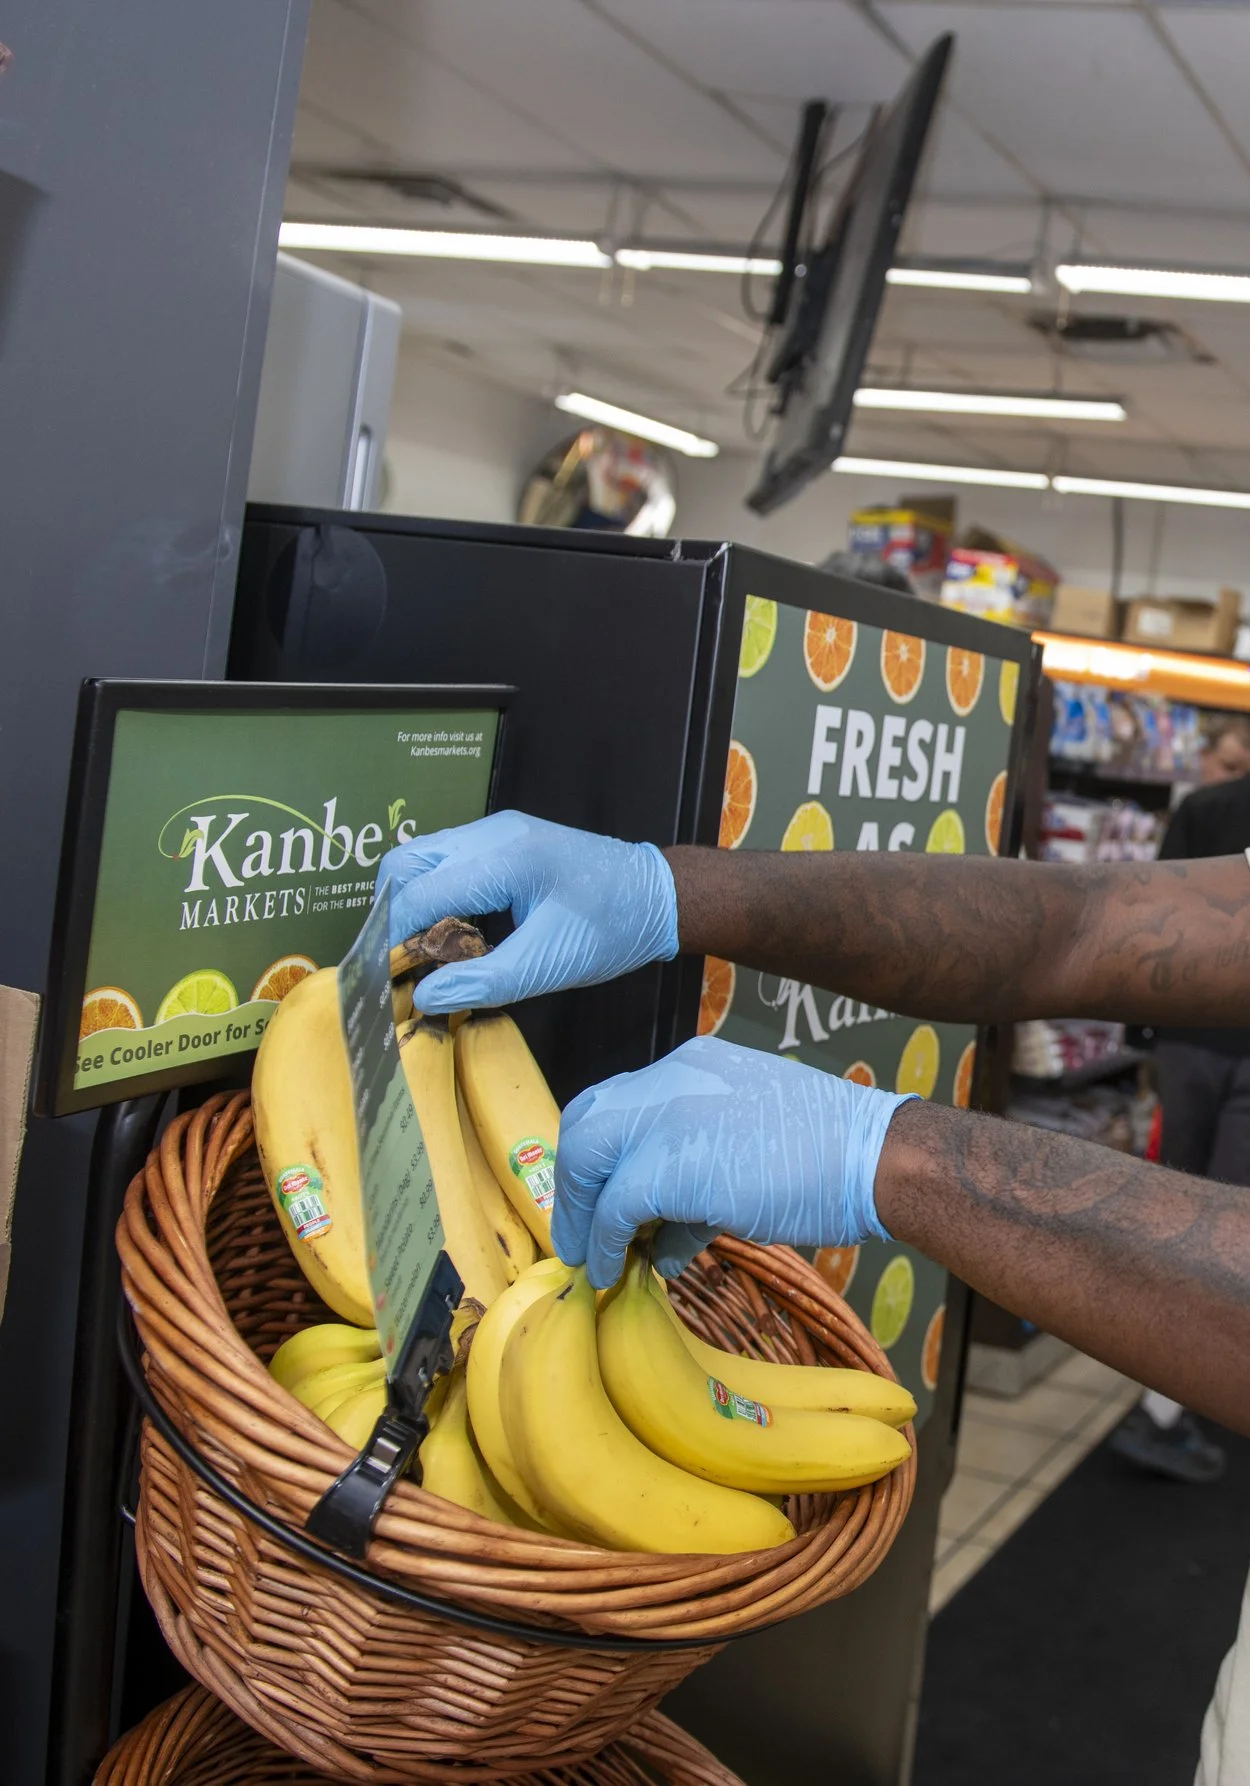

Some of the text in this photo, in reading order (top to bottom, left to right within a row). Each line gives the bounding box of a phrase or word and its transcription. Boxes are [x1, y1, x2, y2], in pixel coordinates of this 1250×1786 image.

[397, 731, 483, 742] For more info visit us at
[411, 746, 481, 758] Kanbesmarkets.org
[807, 704, 966, 804] FRESH
[315, 881, 375, 897] THE BEST PRIC
[180, 887, 306, 930] MARKETS
[313, 902, 328, 912] FOR
[330, 899, 344, 910] THE
[346, 897, 367, 908] BEST
[110, 1040, 173, 1066] Cooler
[178, 1030, 221, 1051] Door
[225, 1023, 251, 1042] for
